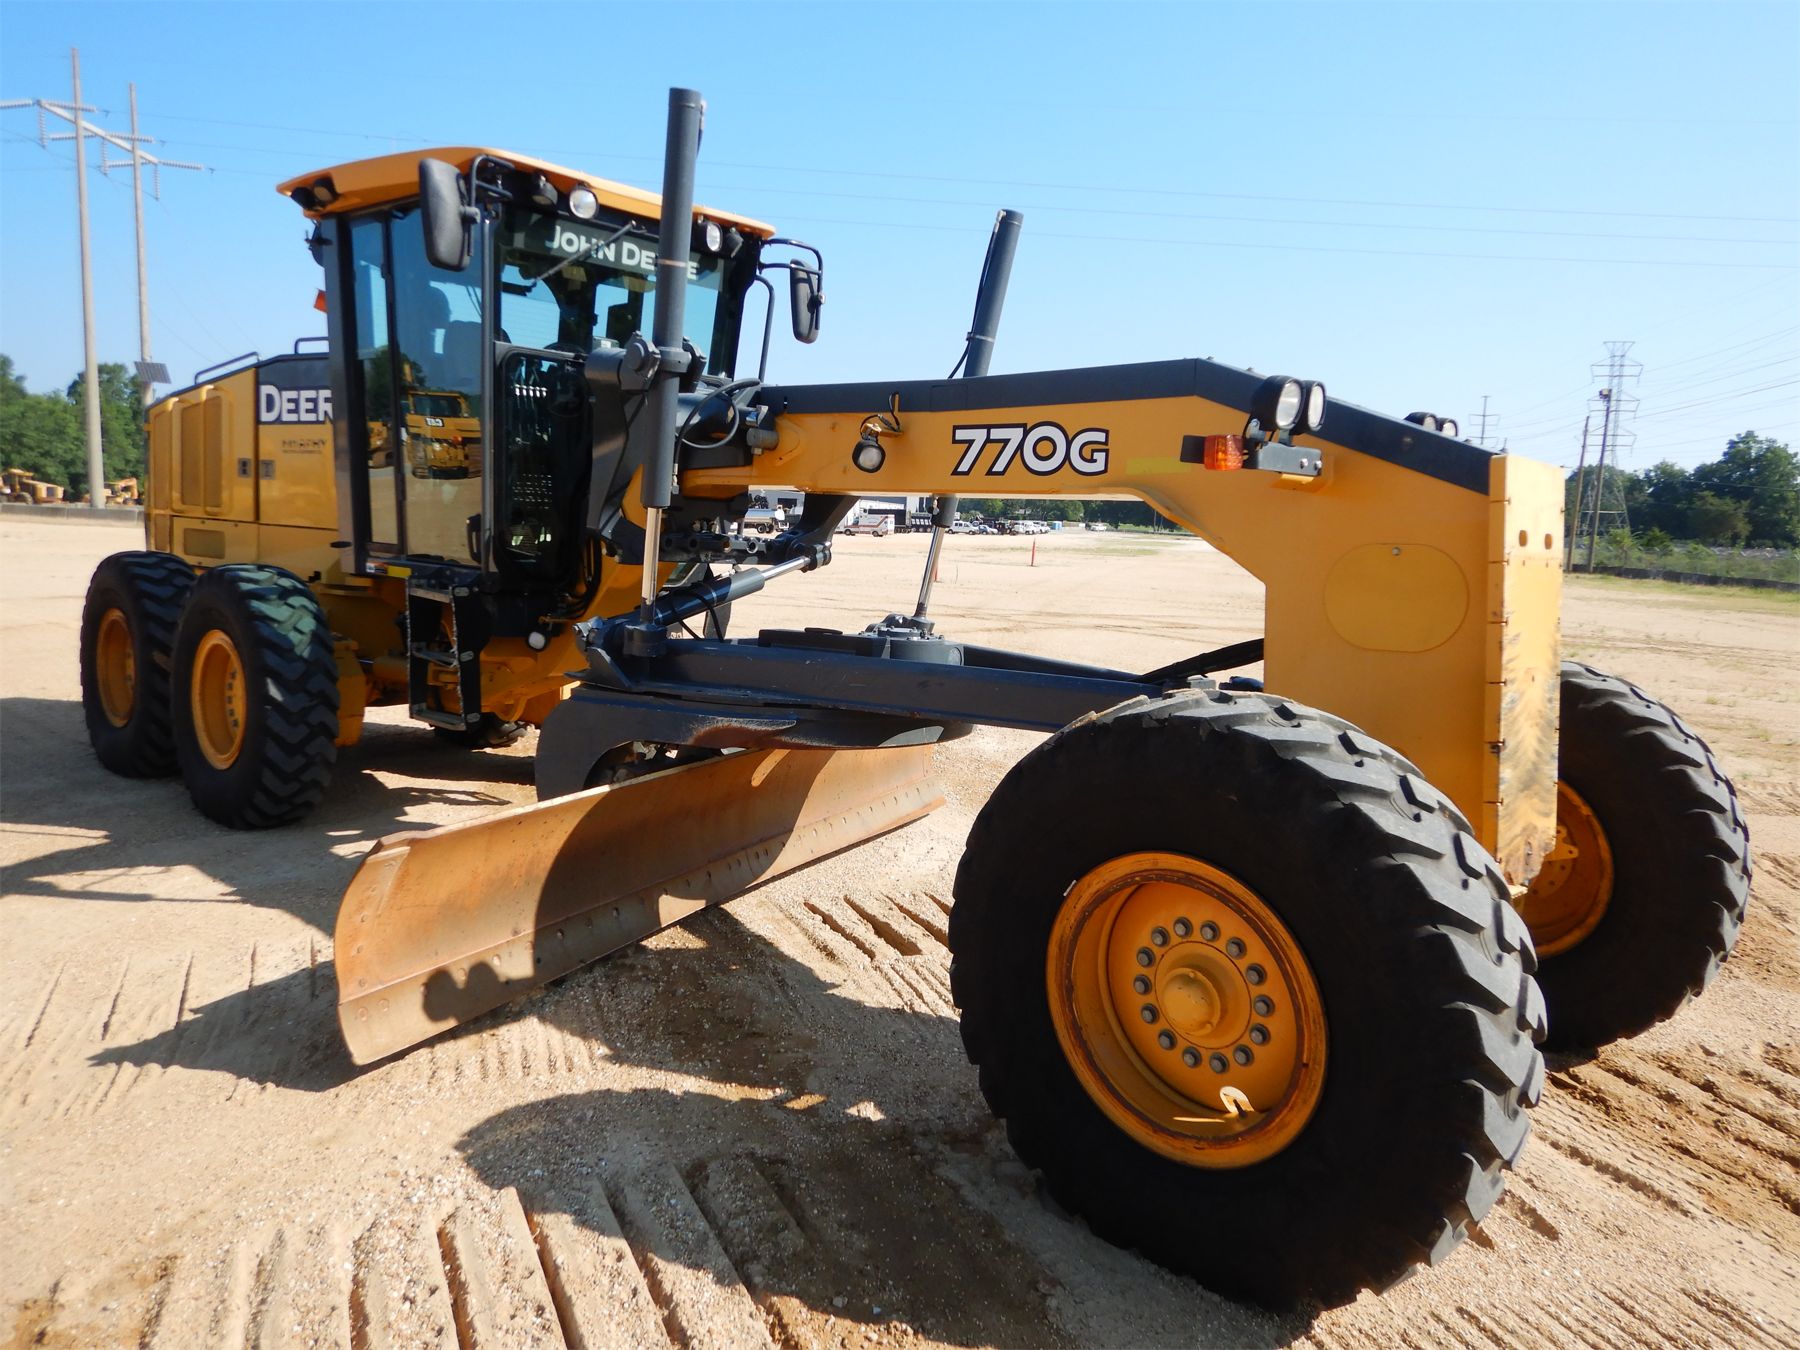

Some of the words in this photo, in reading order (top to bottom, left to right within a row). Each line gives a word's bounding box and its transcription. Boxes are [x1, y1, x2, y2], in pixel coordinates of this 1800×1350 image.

[546, 225, 616, 263] JOHN
[621, 240, 700, 281] DEE
[952, 421, 1109, 476] 770G
